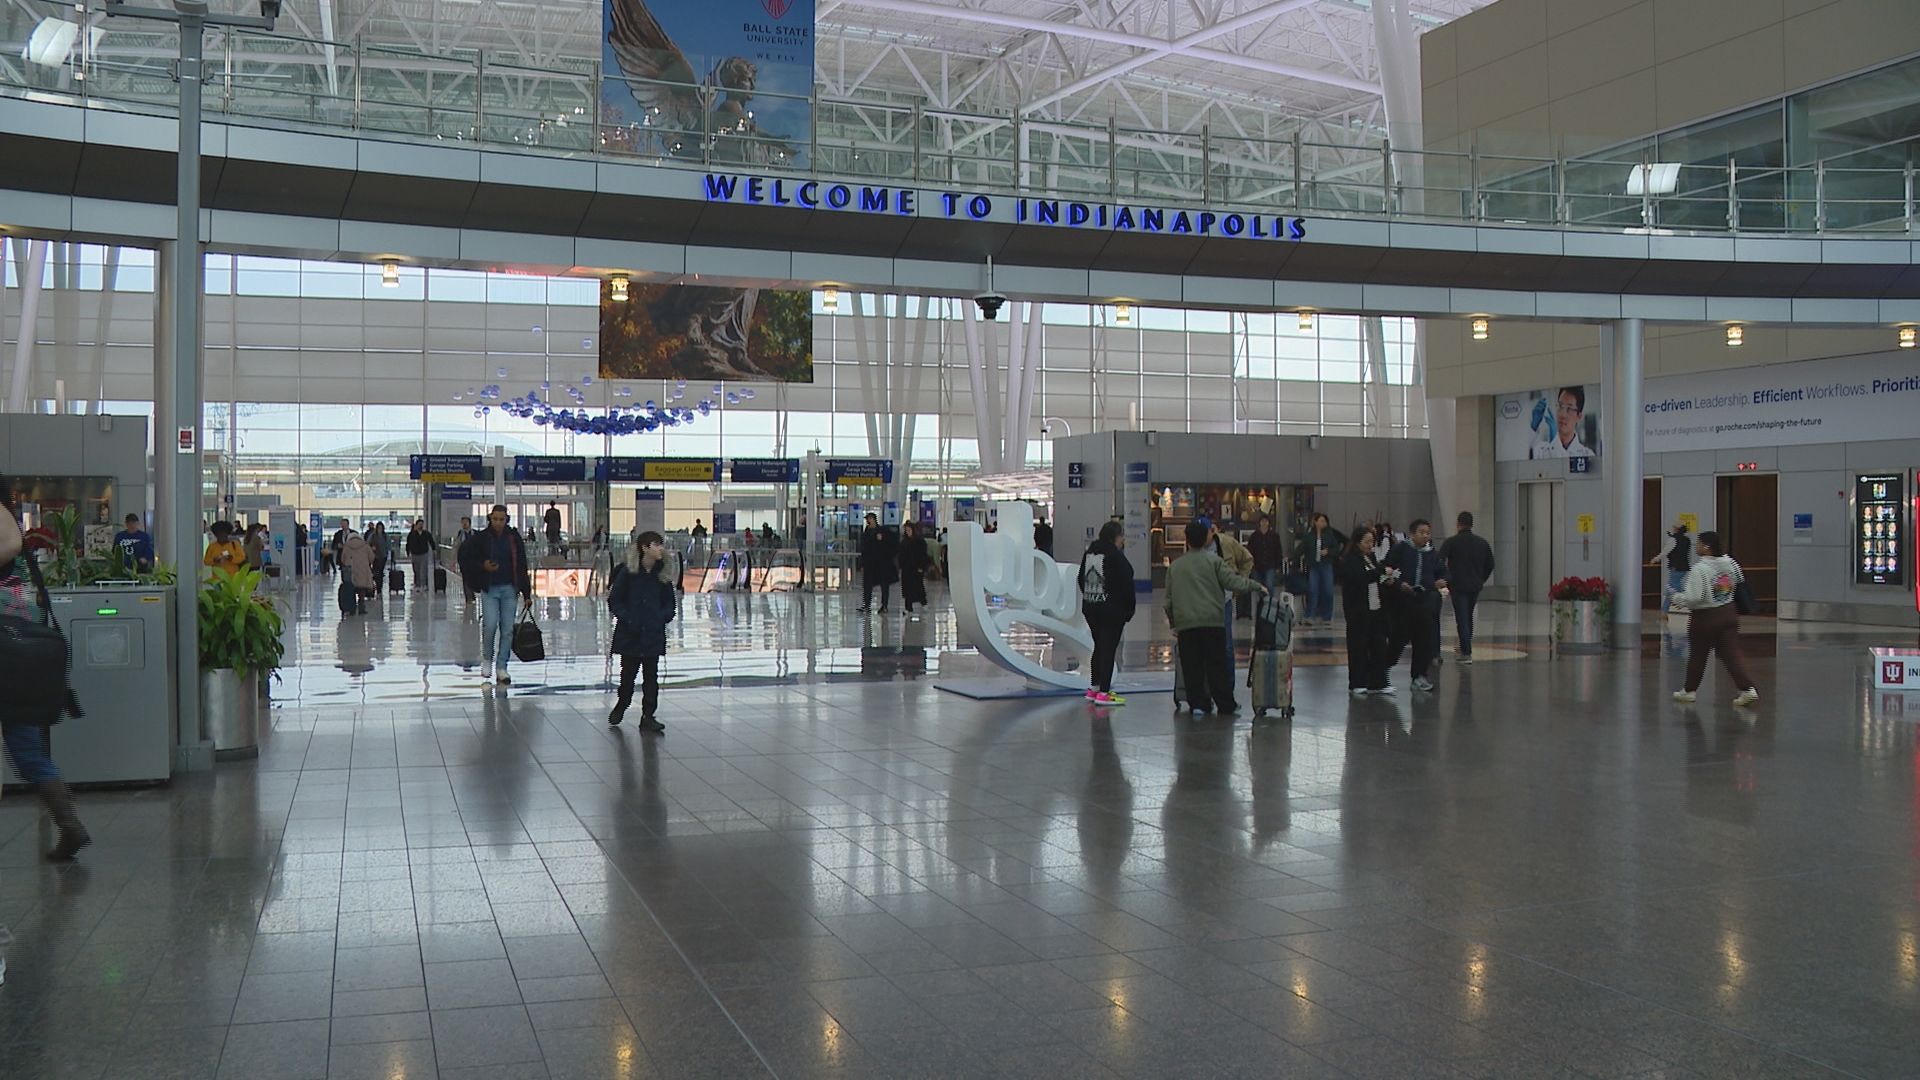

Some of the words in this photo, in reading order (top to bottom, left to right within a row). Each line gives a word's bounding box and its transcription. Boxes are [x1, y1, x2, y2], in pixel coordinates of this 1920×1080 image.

[743, 23, 771, 34] BALL
[775, 26, 809, 37] STATE
[746, 34, 805, 46] UNIVERSITY
[756, 52, 770, 60] WE
[777, 54, 796, 62] FLY
[704, 173, 915, 214] WELCOME
[942, 193, 992, 219] TO
[1017, 199, 1307, 240] INDIANAPOLIS
[1694, 392, 1751, 409] Leadership.
[1753, 388, 1804, 404] Efficient
[1805, 383, 1869, 400] Workflows.
[1872, 375, 1920, 394] Prioriti
[1654, 427, 1670, 436] future
[1678, 425, 1708, 436] diagnostics
[1715, 418, 1822, 434] go.roche.com/shaping-the-future
[655, 465, 683, 473] Baggage
[1073, 464, 1080, 473] 5
[1908, 667, 1920, 677] IN
